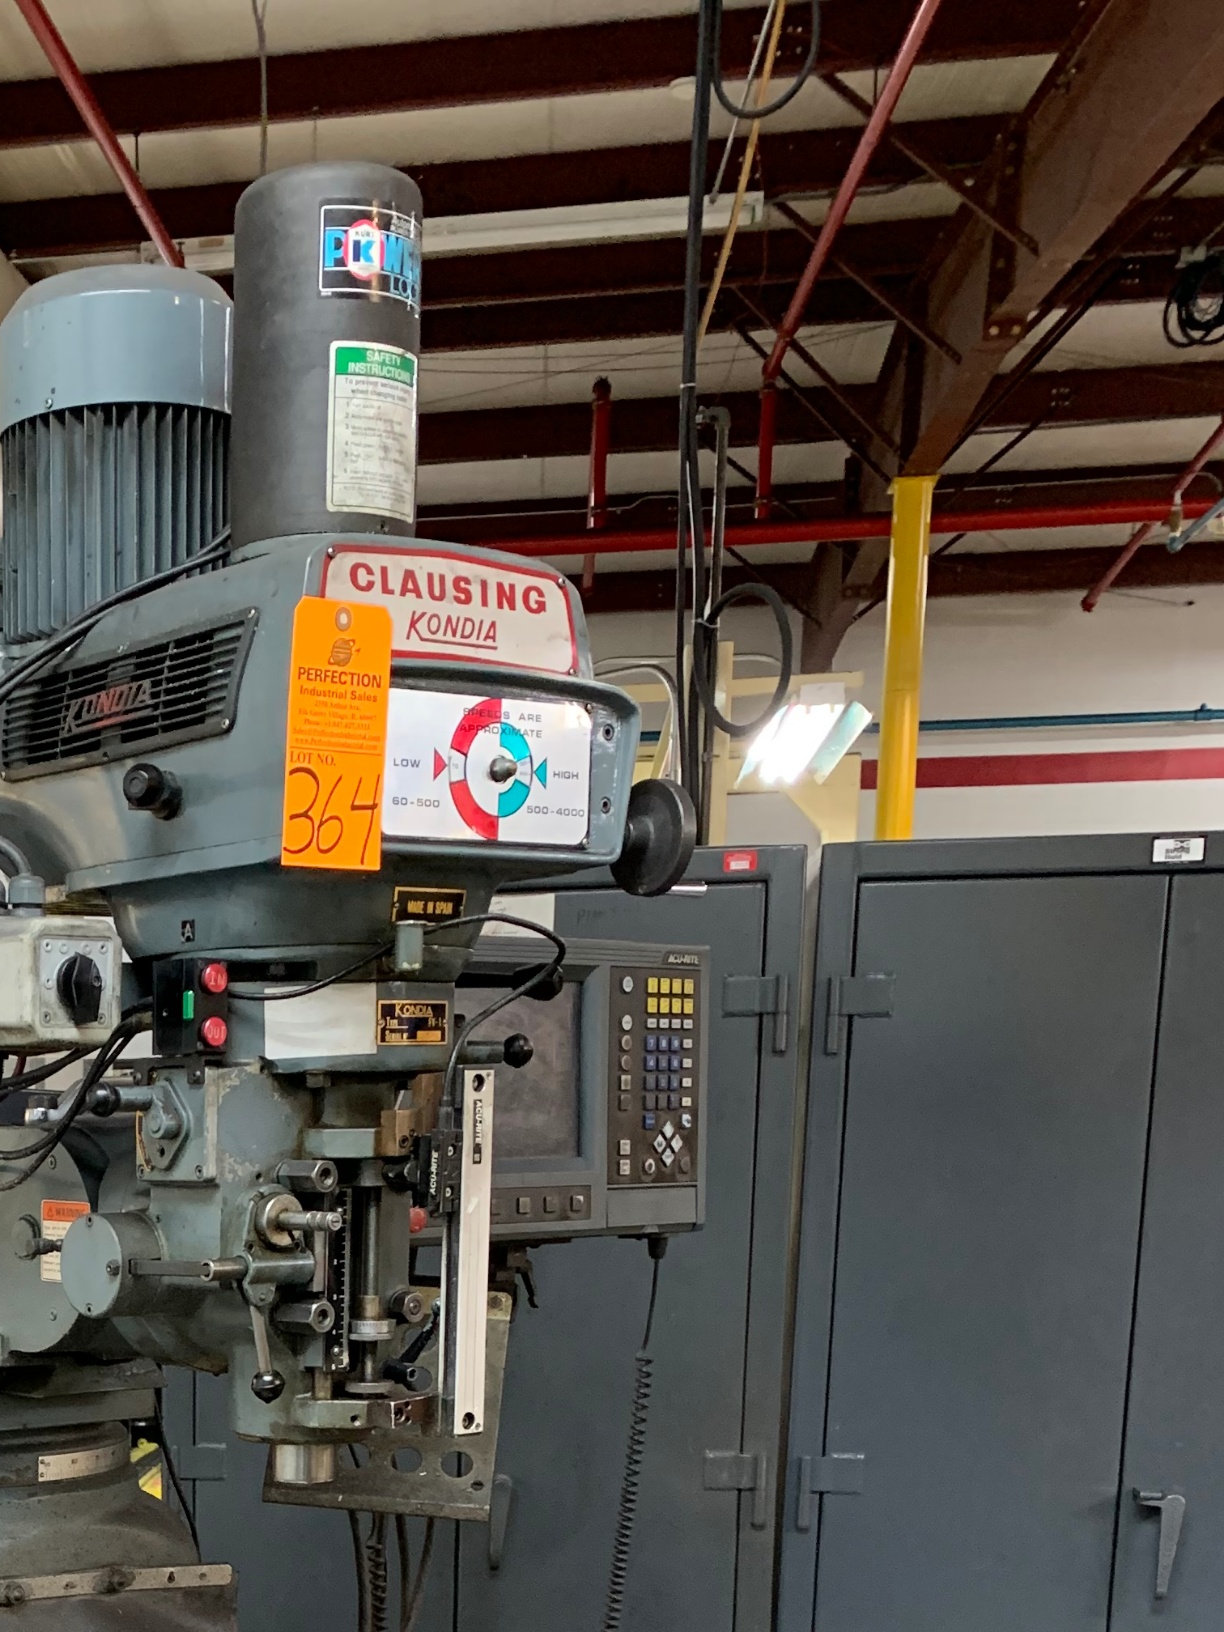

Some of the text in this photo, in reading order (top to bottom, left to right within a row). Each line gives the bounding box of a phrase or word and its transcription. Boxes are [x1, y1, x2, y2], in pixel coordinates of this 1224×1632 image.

[366, 350, 401, 366] SAFETY
[347, 361, 411, 383] INSTRUCTIONS
[349, 561, 547, 615] CLAUSING
[405, 610, 498, 649] KONDIA
[297, 666, 382, 688] PERFECTION
[299, 684, 378, 702] Industrial Sales
[61, 679, 153, 734] KONDIA
[462, 707, 542, 723] SPEEDS ARE
[460, 724, 542, 738] APPROXIMATE
[290, 750, 337, 766] LOT NO.
[393, 758, 421, 768] LOW
[553, 770, 579, 780] HIGH
[392, 796, 440, 808] 60-500
[283, 766, 380, 865] 364
[526, 805, 585, 818] 500-4000
[407, 900, 425, 914] MADE
[435, 901, 453, 915] SPAIN
[668, 953, 700, 964] ACU-RITE
[209, 971, 226, 985] IN
[395, 1003, 433, 1017] KONDIA
[207, 1025, 227, 1039] OUT
[429, 1150, 439, 1195] ACU-RITE
